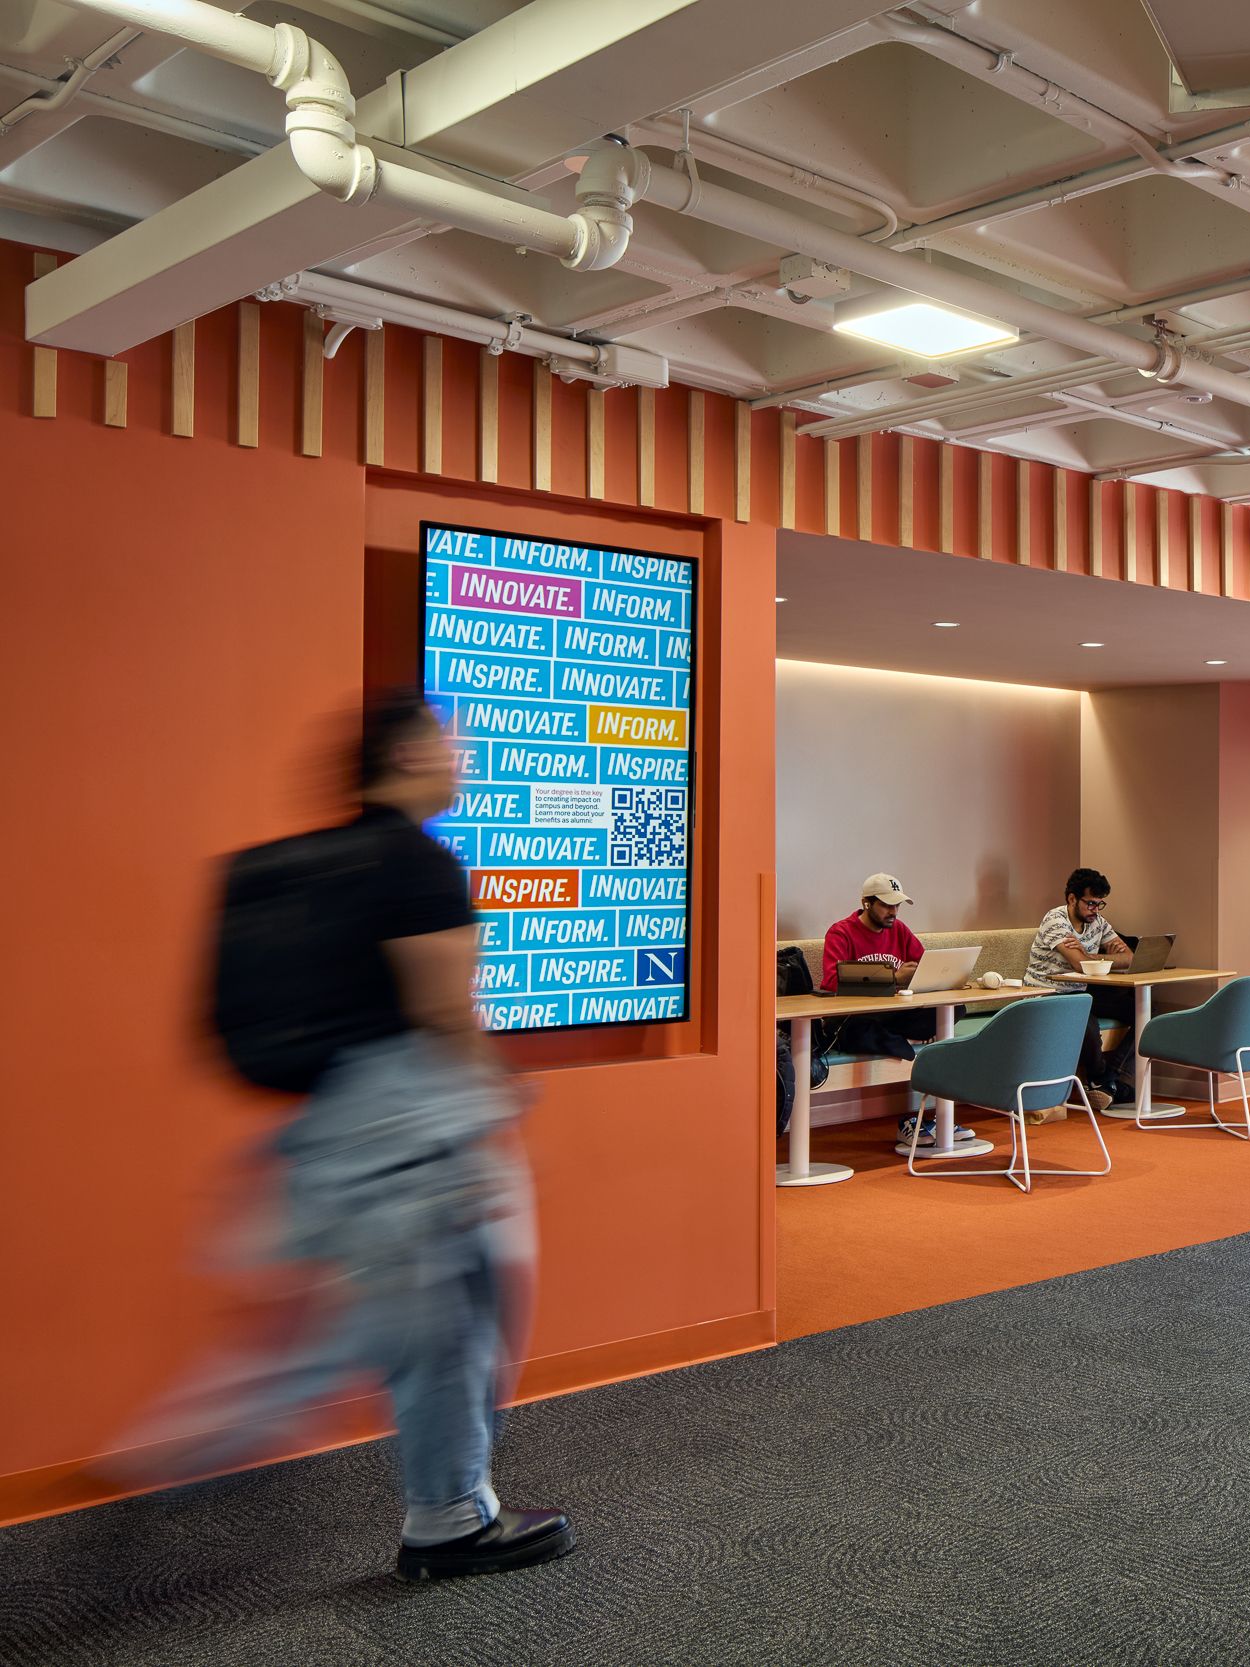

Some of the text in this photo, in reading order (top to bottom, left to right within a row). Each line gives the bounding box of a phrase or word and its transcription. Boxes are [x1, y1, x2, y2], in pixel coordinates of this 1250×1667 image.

[504, 539, 592, 572] INFORM.
[460, 572, 574, 611] INNOVATE.
[593, 588, 674, 621] INFORM.
[429, 613, 545, 650] INNOVATE.
[565, 626, 648, 659] INFORM.
[448, 659, 542, 692] INSPIRE.
[562, 668, 665, 700] INNOVATE.
[466, 703, 578, 736] INNOVATE.
[597, 712, 679, 741] INFORM.
[500, 748, 589, 777] INFORM.
[489, 833, 599, 860] INNOVATE.
[479, 876, 571, 902] INSPIRE.
[889, 880, 900, 891] LA
[521, 917, 608, 943] INFORM.
[539, 958, 626, 984] INSPIRE.
[645, 952, 677, 980] N
[580, 996, 682, 1022] INNOVATE.
